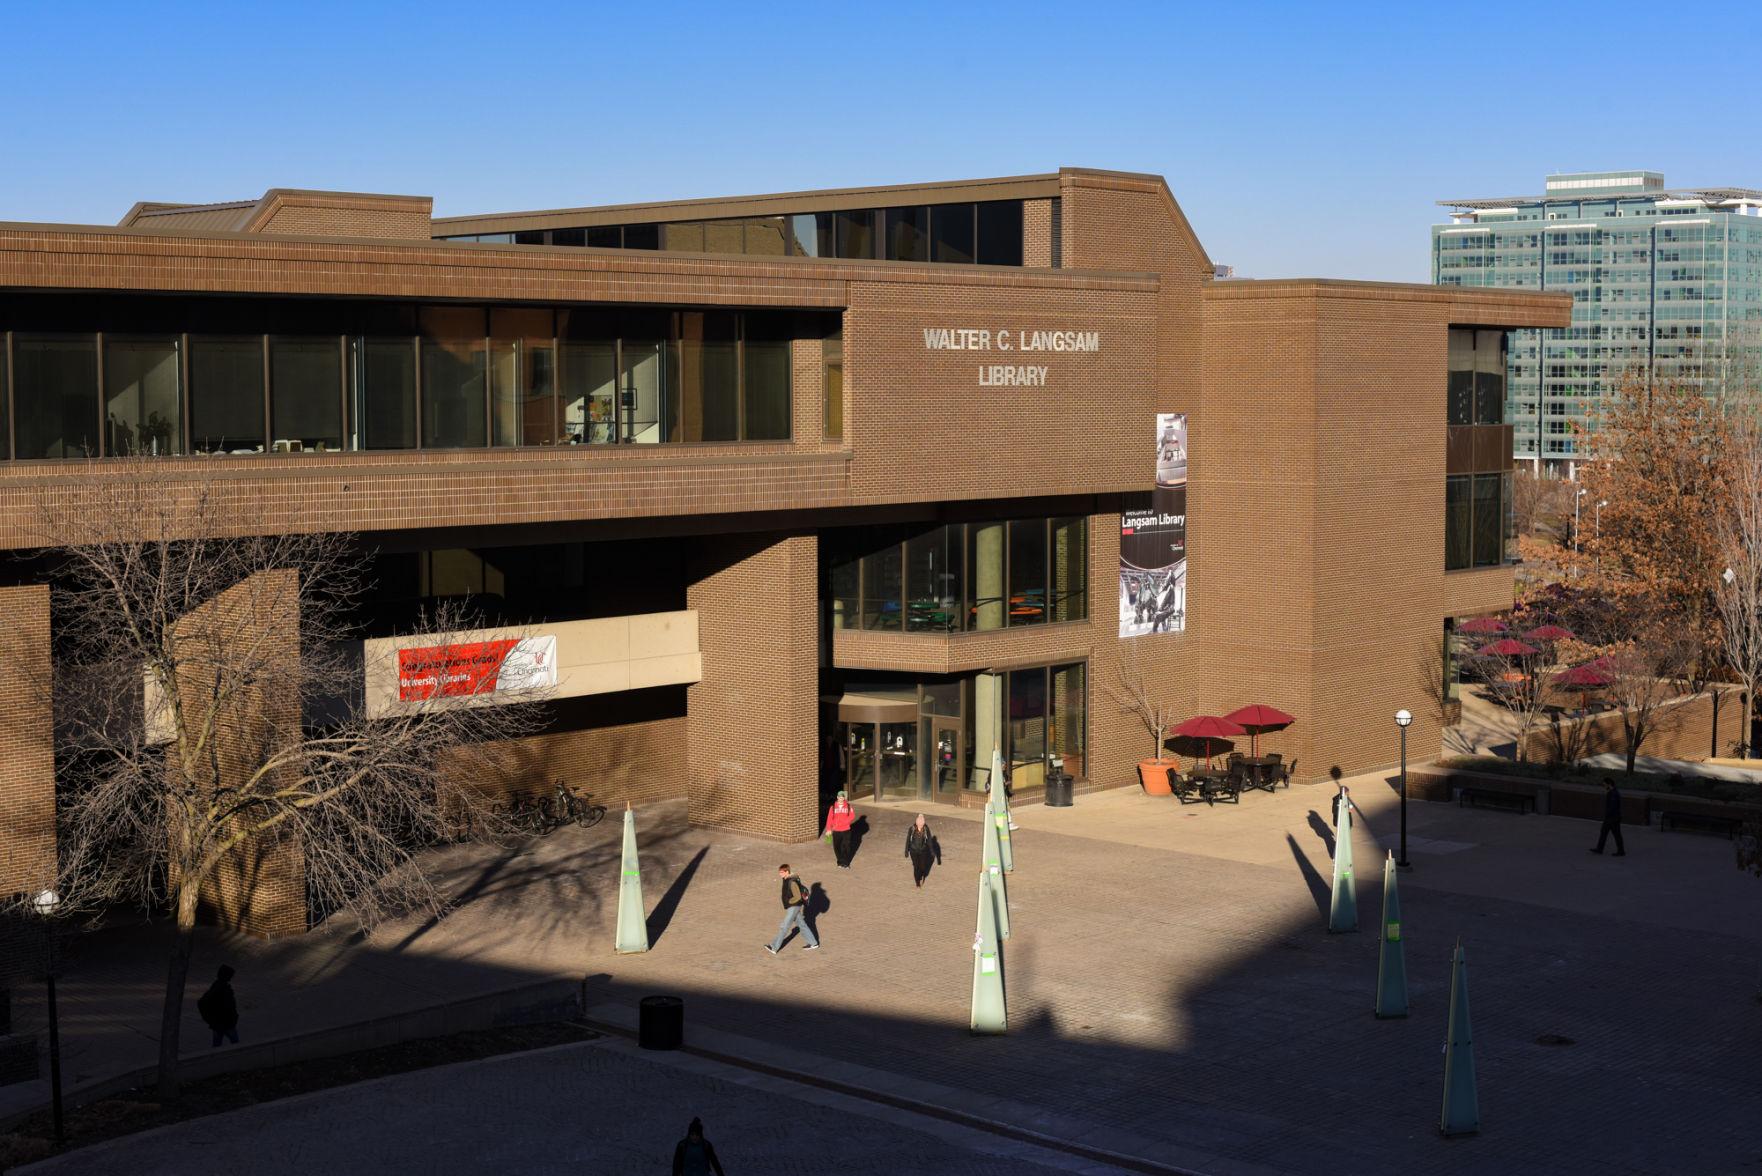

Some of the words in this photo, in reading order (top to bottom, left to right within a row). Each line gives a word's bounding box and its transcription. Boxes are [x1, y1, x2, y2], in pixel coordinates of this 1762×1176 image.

[923, 328, 991, 350] WALTER
[997, 330, 1014, 351] C.
[1020, 330, 1099, 352] LANGSAM
[979, 365, 1048, 386] LIBRARY
[1122, 516, 1158, 530] Langsam
[1158, 513, 1185, 527] Library
[401, 656, 470, 672] Congratuations
